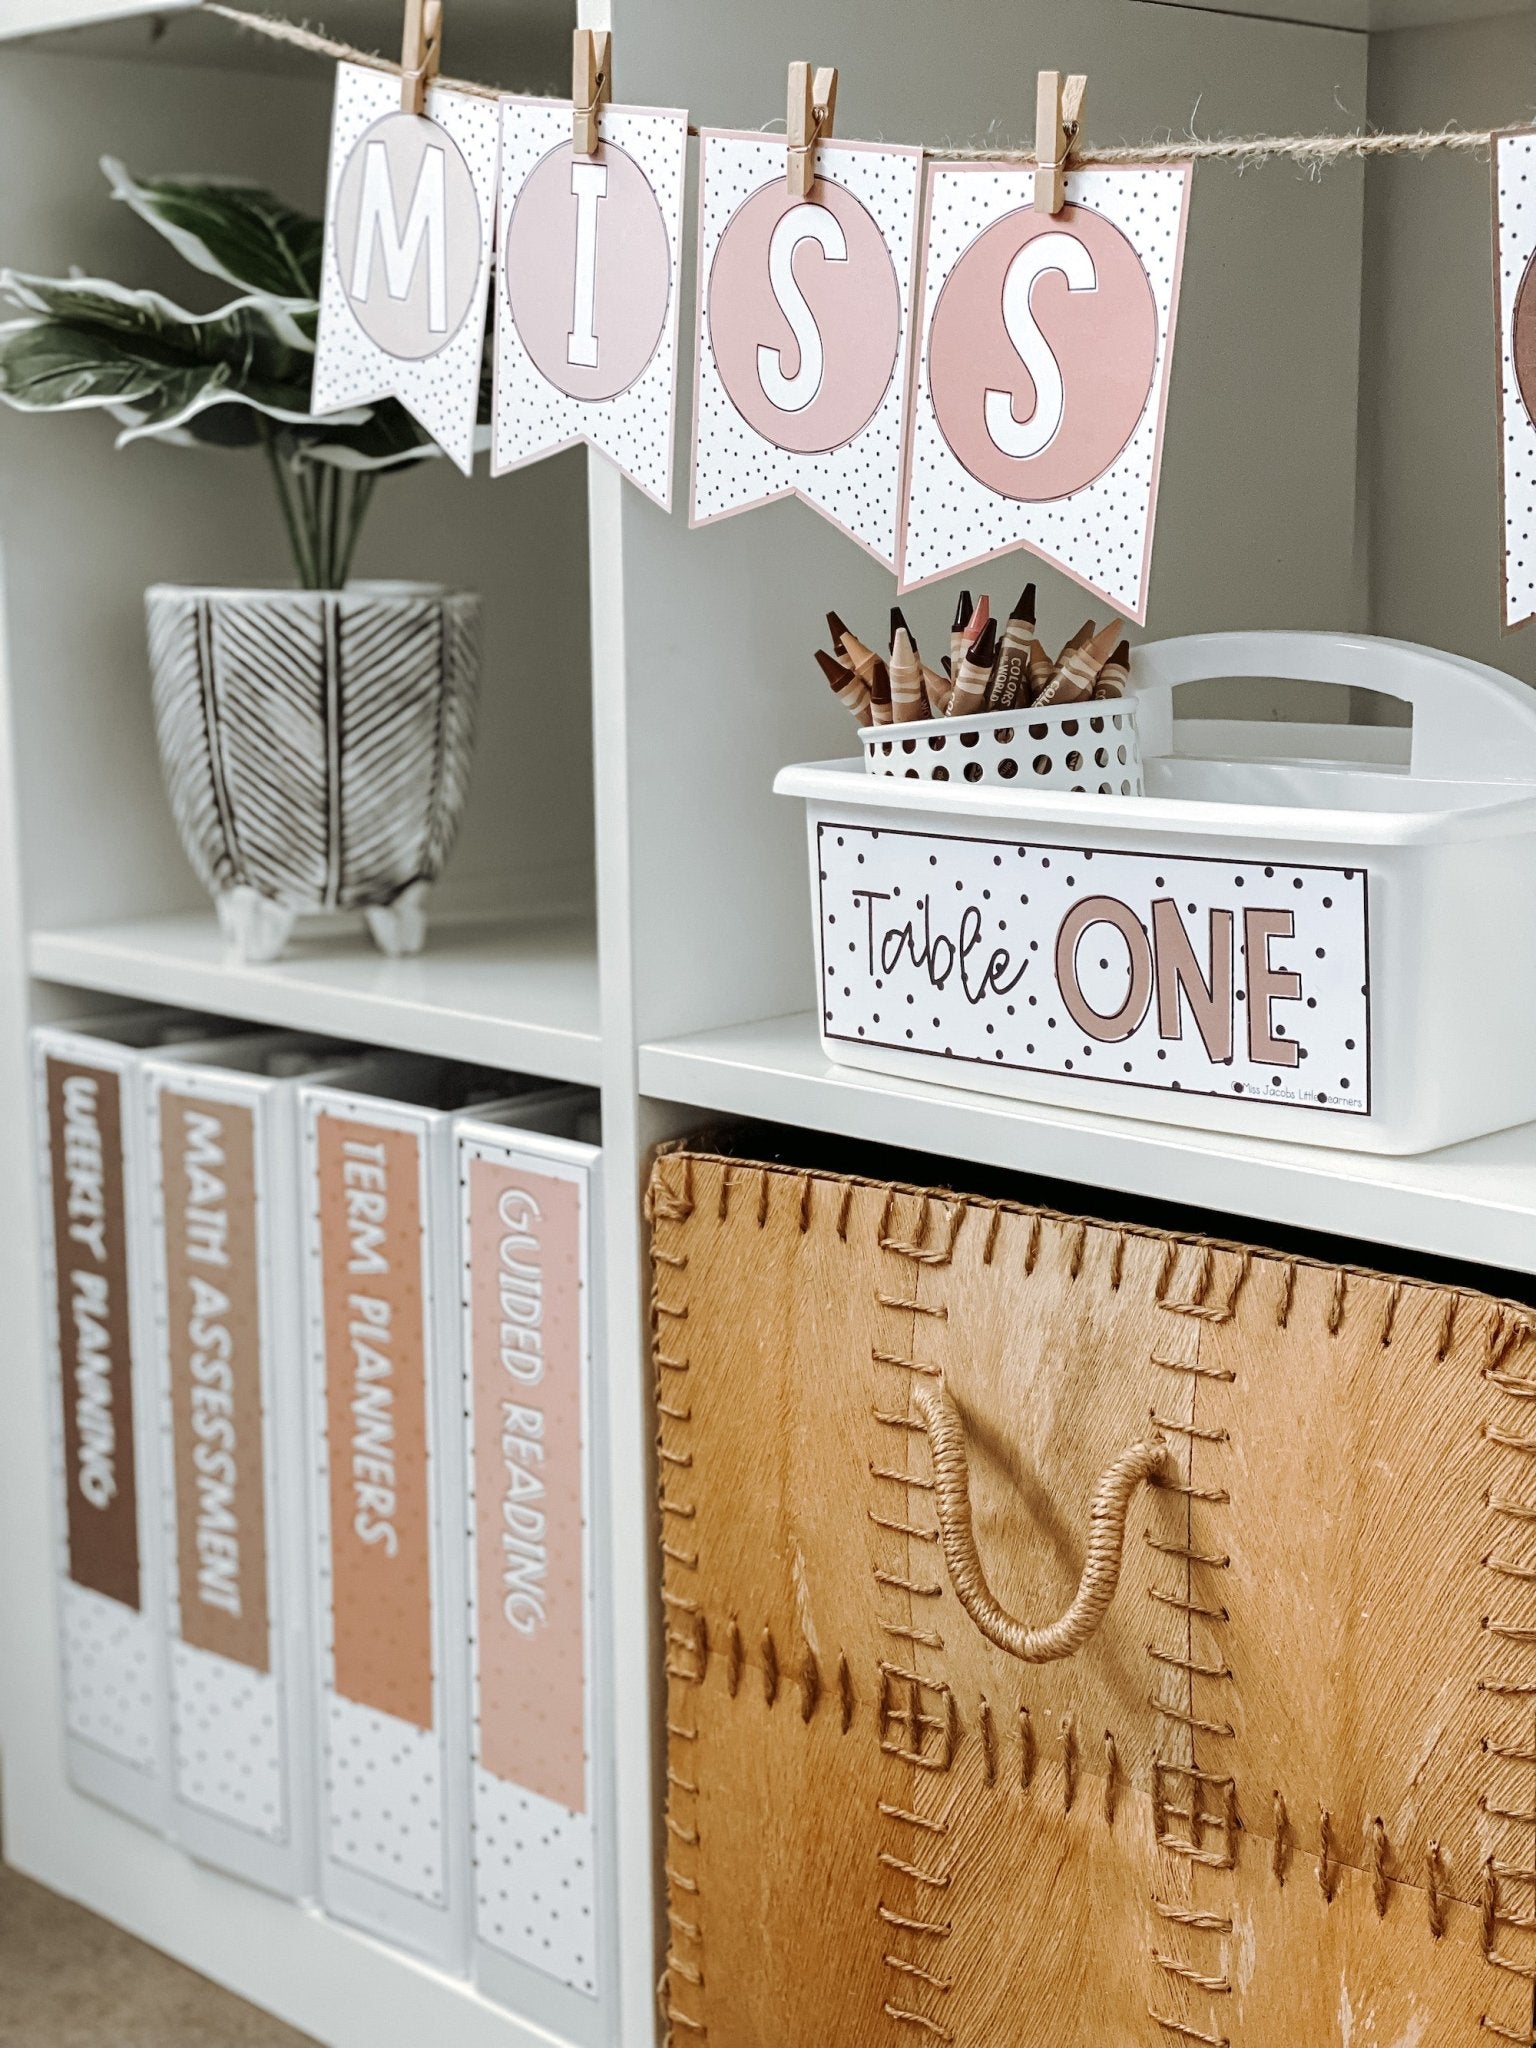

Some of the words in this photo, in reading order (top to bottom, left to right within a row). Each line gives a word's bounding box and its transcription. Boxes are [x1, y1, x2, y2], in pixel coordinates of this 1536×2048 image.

[990, 665, 1009, 702] WORLD
[1001, 657, 1022, 707] COLORS
[852, 889, 1029, 1004] Table
[1055, 894, 1302, 1068] ONE
[62, 1075, 106, 1261] WEEKLY
[1262, 1085, 1296, 1099] Jacobs
[1322, 1093, 1363, 1108] earners
[182, 1110, 229, 1268] MATH
[342, 1136, 389, 1276] TERM
[497, 1187, 544, 1386] GUIDED
[71, 1270, 118, 1510] PLANNING
[188, 1276, 242, 1618] ASSESSMENT
[347, 1294, 397, 1558] PLANNERS
[500, 1402, 548, 1636] READING
